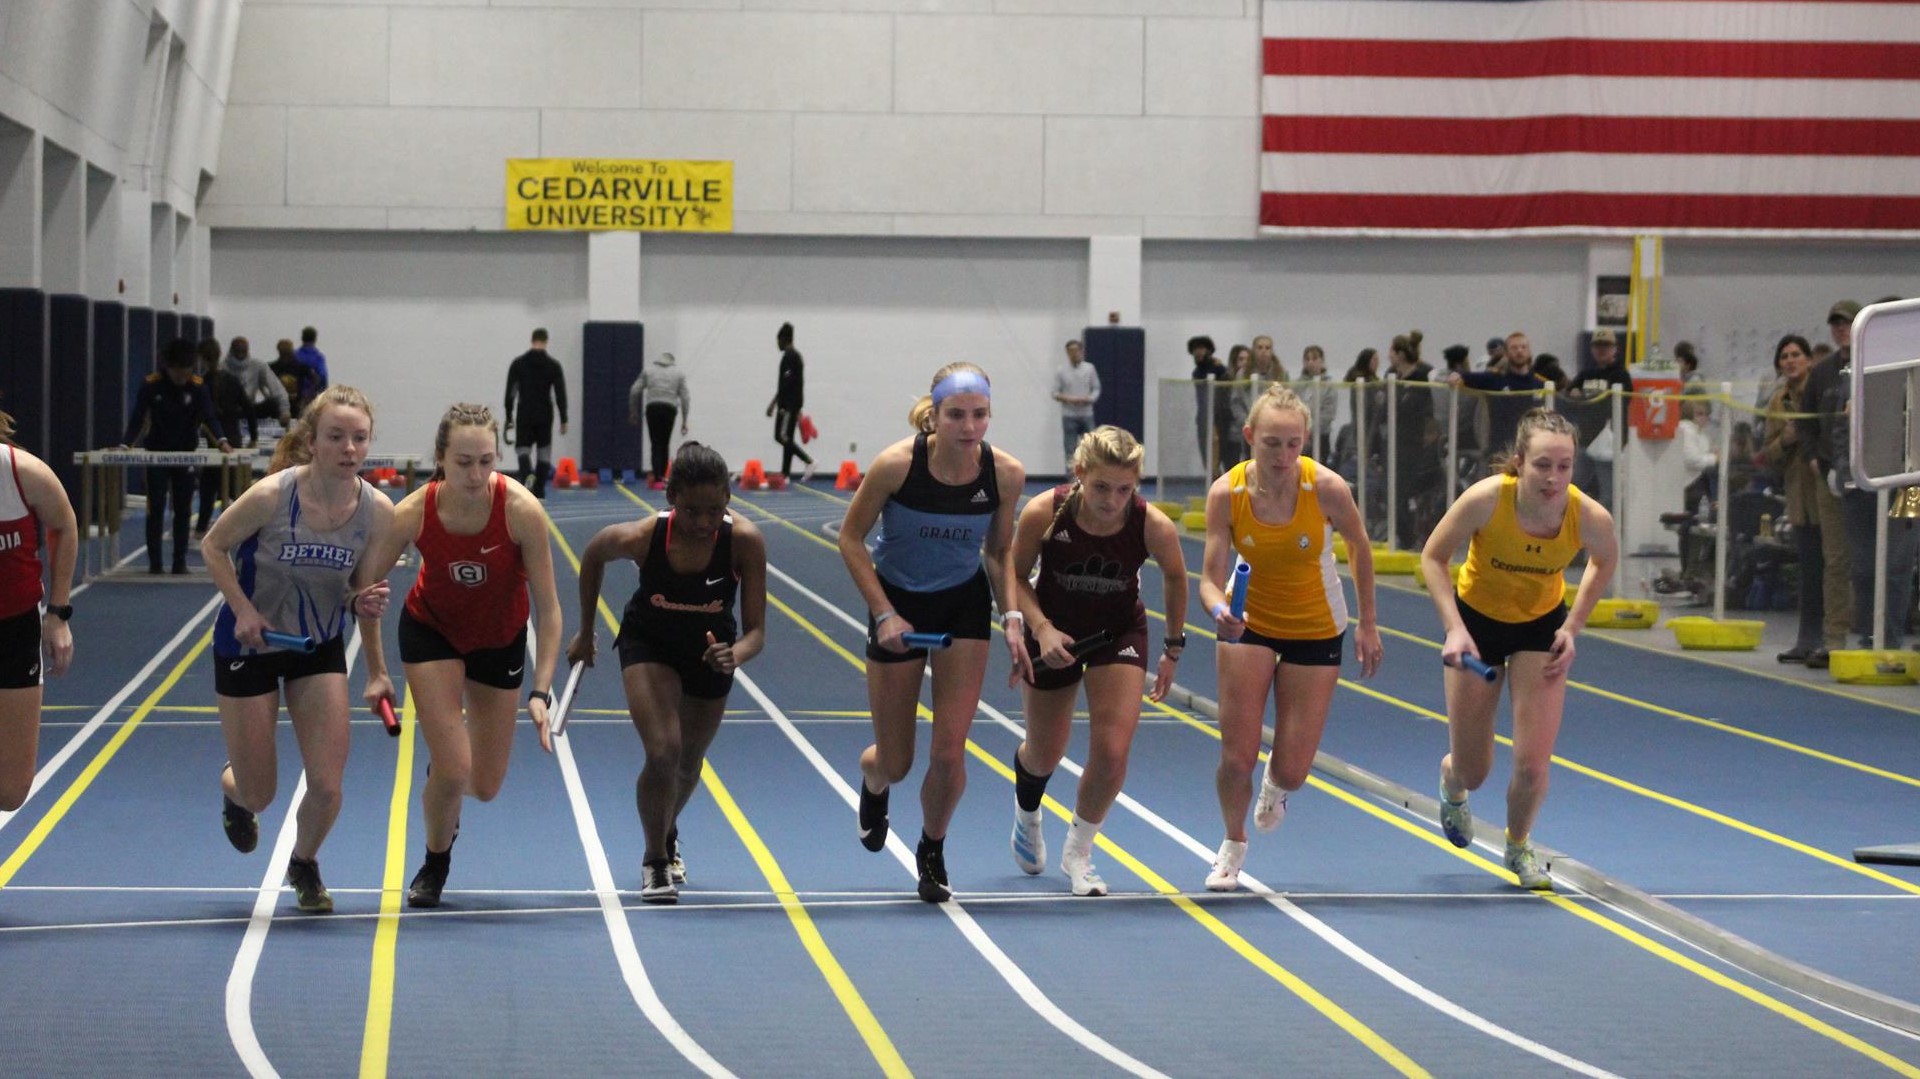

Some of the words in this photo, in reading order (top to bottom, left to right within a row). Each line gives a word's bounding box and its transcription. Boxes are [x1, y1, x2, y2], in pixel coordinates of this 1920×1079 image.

[572, 162, 644, 174] Welcome
[650, 162, 668, 175] To
[517, 176, 722, 202] CEDARVILLE
[526, 204, 689, 226] UNIVERSITY
[102, 453, 154, 463] CEDARVILLE
[157, 454, 209, 464] UNIVERSITY
[919, 525, 973, 541] GRACE
[279, 543, 354, 567] BETHEL
